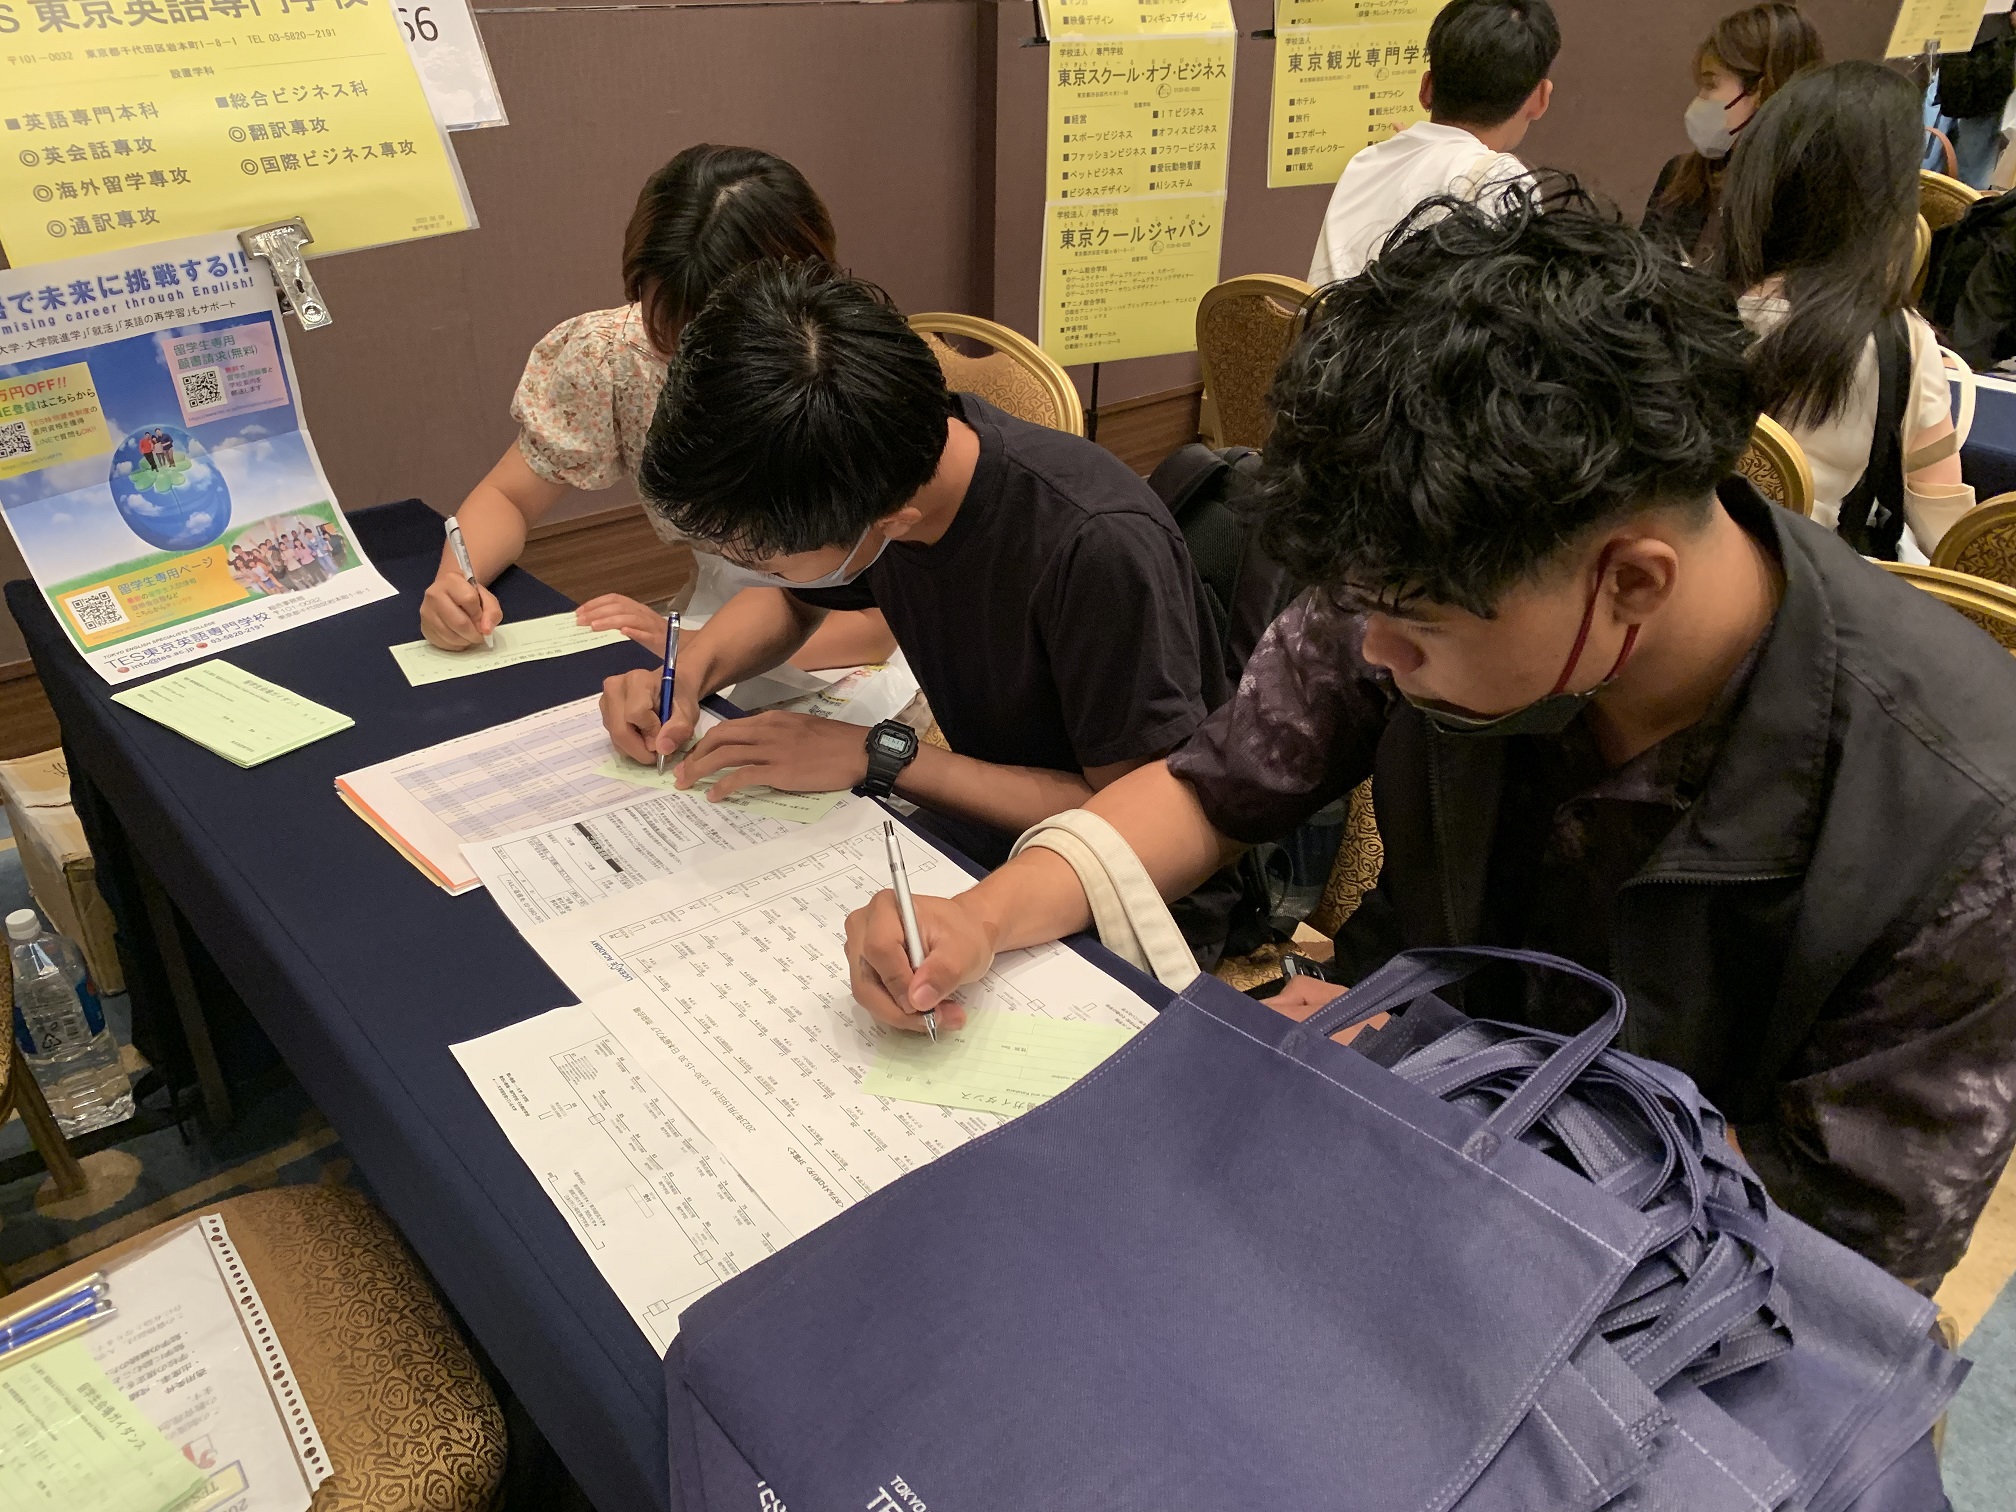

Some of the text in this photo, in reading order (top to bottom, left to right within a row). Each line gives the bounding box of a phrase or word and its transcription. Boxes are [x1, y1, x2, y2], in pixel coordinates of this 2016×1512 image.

[1070, 15, 1114, 25] 映像デザイン
[1147, 12, 1207, 23] フィギュアデザイン
[247, 34, 265, 44] TEL
[268, 28, 337, 43] 03-5820-2191
[1285, 38, 1311, 46] 学校法人
[169, 65, 216, 79] 設置学科
[1057, 63, 1226, 87] 東京スクール・オブ・ビジネス
[229, 80, 369, 110] 総合ビジネス科
[1376, 90, 1404, 99] エアライン
[24, 101, 160, 132] 英語専門本科
[1376, 105, 1414, 116] 観光ビジネス
[1071, 114, 1087, 124] 経営
[1295, 114, 1310, 122] 旅行
[248, 117, 330, 142] 翻訳専攻
[1158, 125, 1217, 137] オフィスビジネス
[1295, 129, 1327, 139] エアポート
[1070, 130, 1133, 143] スポーツビジネス
[43, 136, 157, 166] 英会話専攻
[1070, 147, 1147, 162] ファッションビジネス
[1158, 143, 1216, 155] フラワービジネス
[1294, 144, 1345, 156] 葬祭ディレクター
[261, 139, 417, 175] 国際ビジネス専攻
[1292, 162, 1314, 171] IT観光
[1070, 168, 1124, 180] ペットビジネス
[56, 167, 191, 201] 海外留学専攻
[1156, 179, 1193, 190] AIシステム
[1069, 185, 1131, 198] ビジネスデザイン
[70, 207, 160, 237] 通訳専攻
[1060, 219, 1211, 249] 東京クールジャパン
[66, 303, 117, 322] career
[125, 289, 184, 310] through
[193, 276, 255, 296] English!
[174, 335, 236, 356] 留学生専用
[178, 345, 258, 370] 願書請求(無料)
[117, 556, 213, 596] 留学生専用ページ
